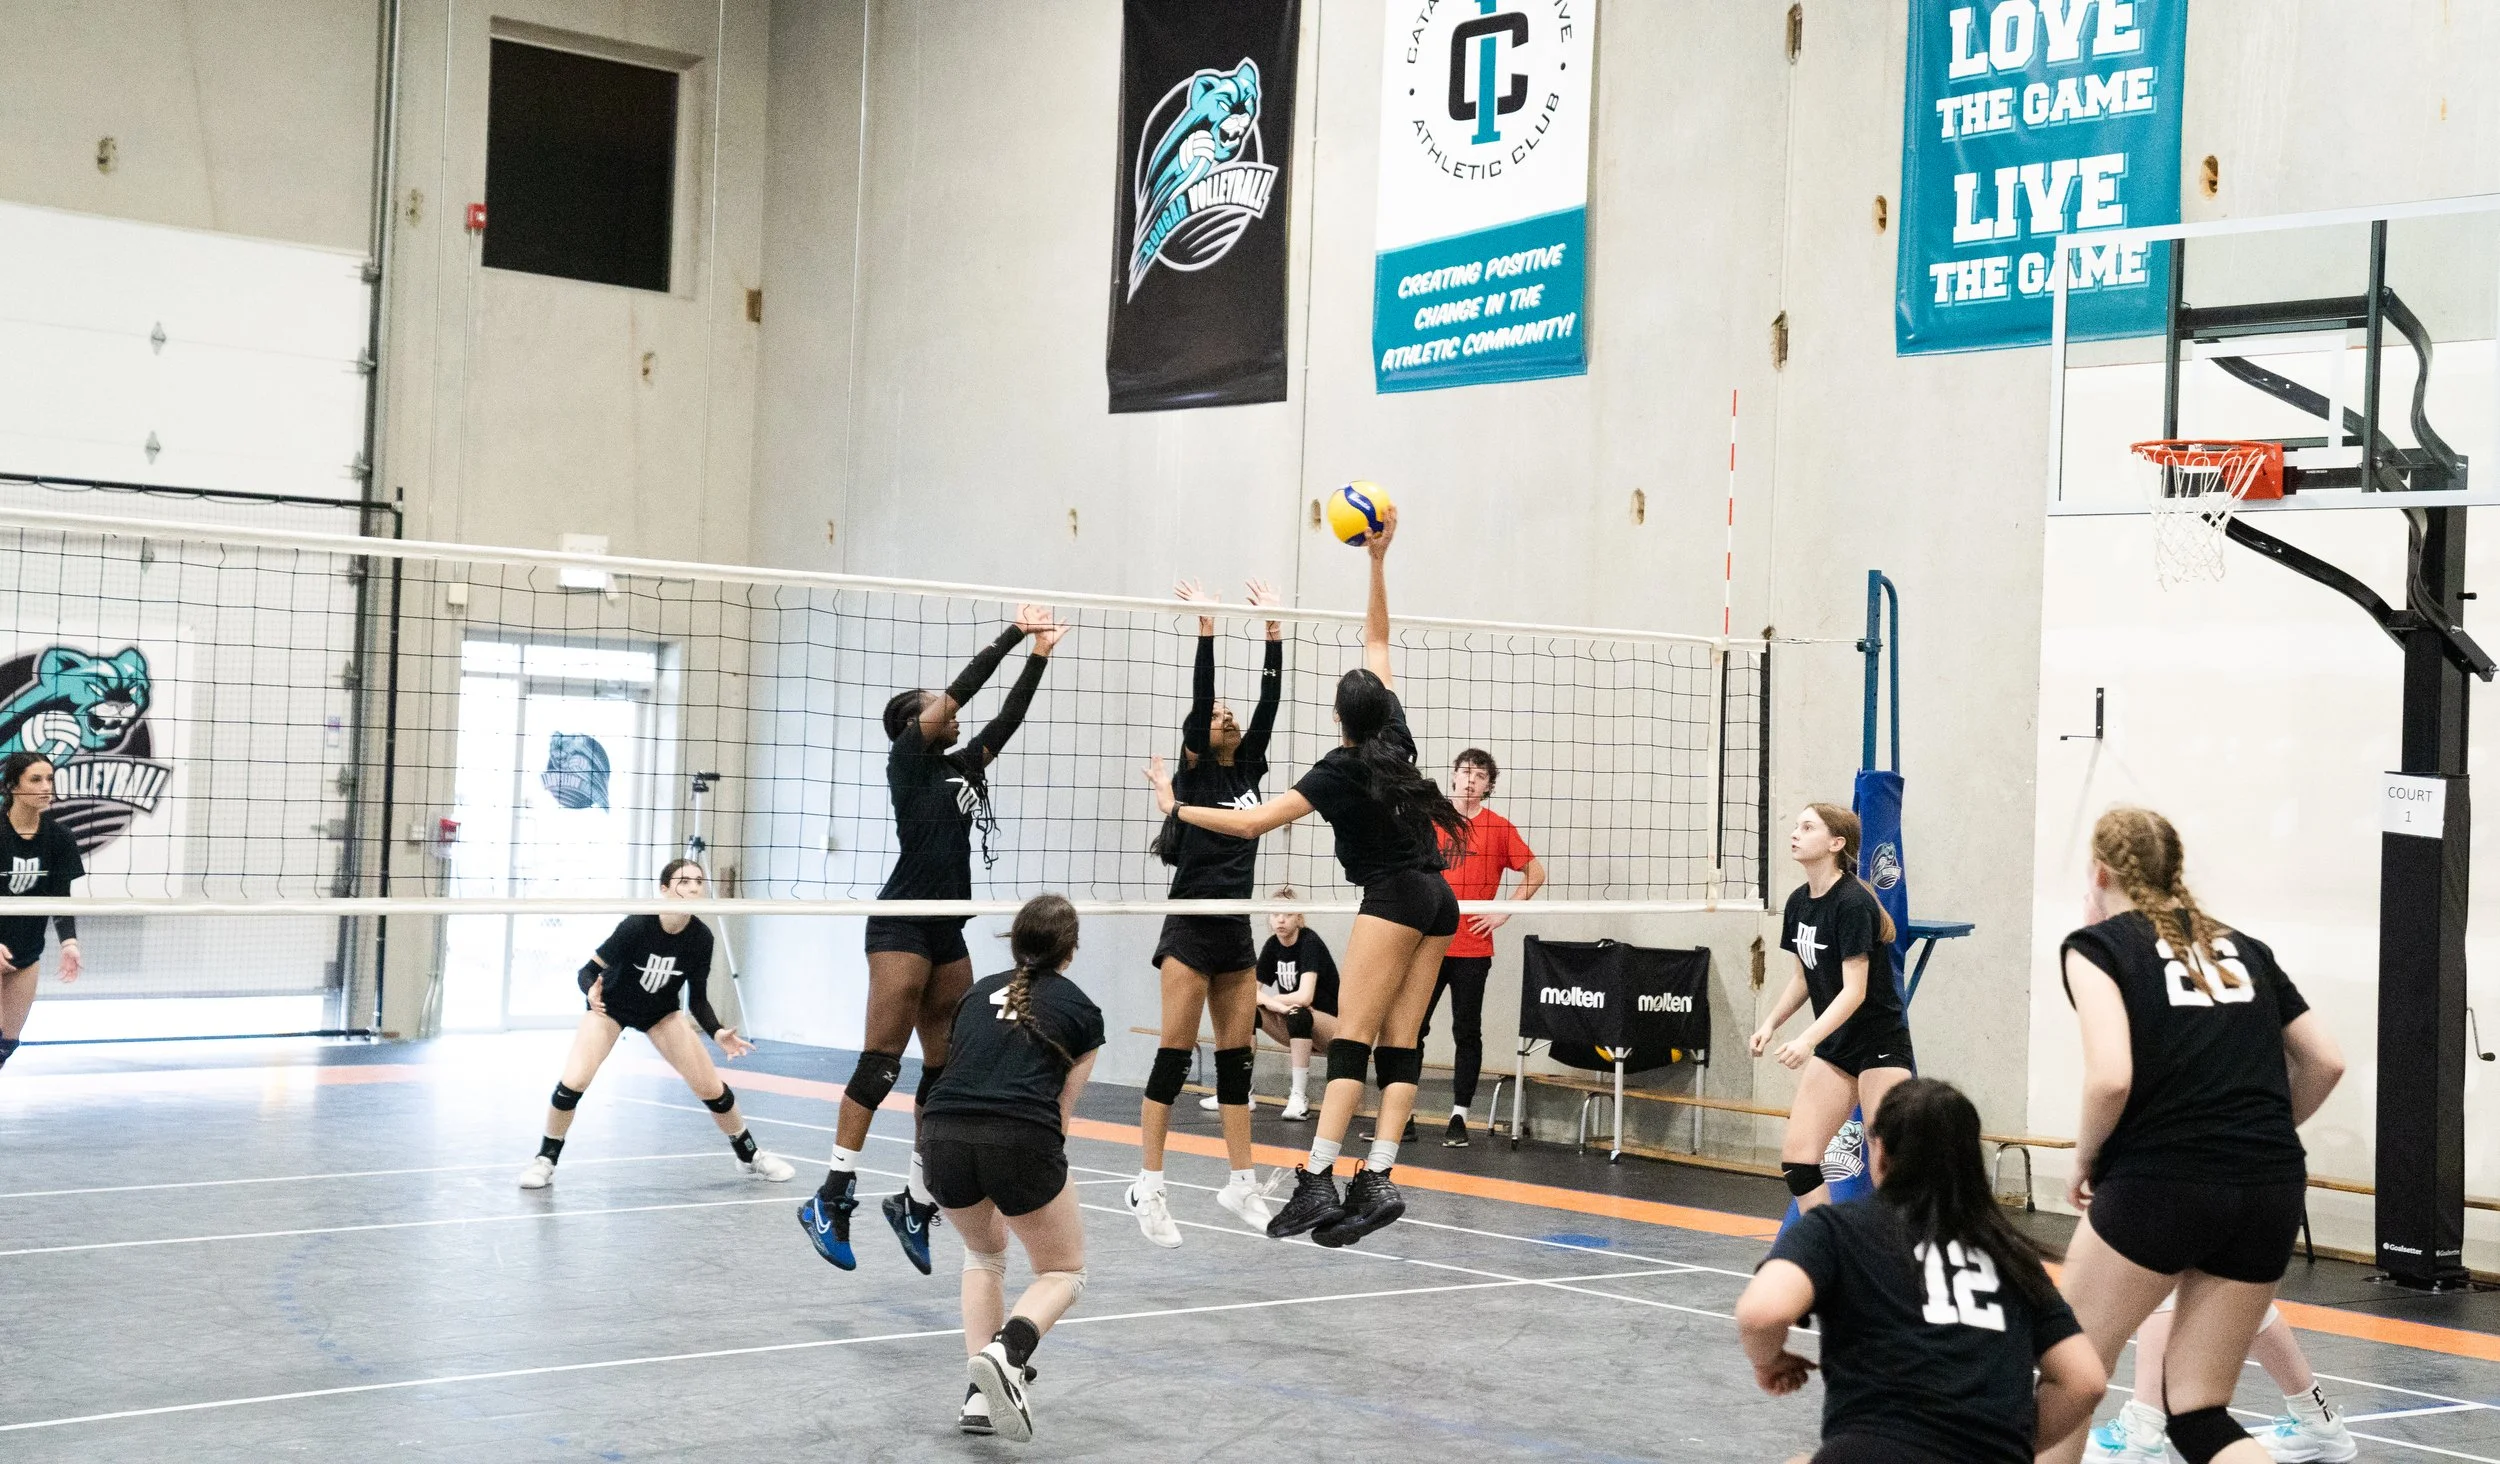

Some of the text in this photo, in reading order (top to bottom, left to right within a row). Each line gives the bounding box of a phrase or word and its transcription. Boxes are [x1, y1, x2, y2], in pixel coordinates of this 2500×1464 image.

[1949, 0, 2142, 80] LOVE
[1936, 66, 2155, 139] THE GAME
[1412, 92, 1560, 180] ATHLETIC CLUB
[1142, 167, 1272, 257] COUGAR VOLLEYBALL
[1952, 152, 2125, 244] LIVE
[1398, 242, 1567, 300] CREATING POSITIVE
[1929, 255, 2010, 304] THE
[1414, 283, 1546, 331] CHANGE IN THE
[1381, 312, 1577, 372] ATHLETIC COMMUNITY!
[54, 761, 171, 811] OLLEYBALL
[2388, 786, 2433, 803] COURT
[2405, 810, 2412, 823] 1
[1540, 986, 1606, 1009] molten
[1638, 992, 1693, 1013] molten
[2389, 1243, 2422, 1256] Goalsetter
[1913, 1240, 2007, 1332] 12
